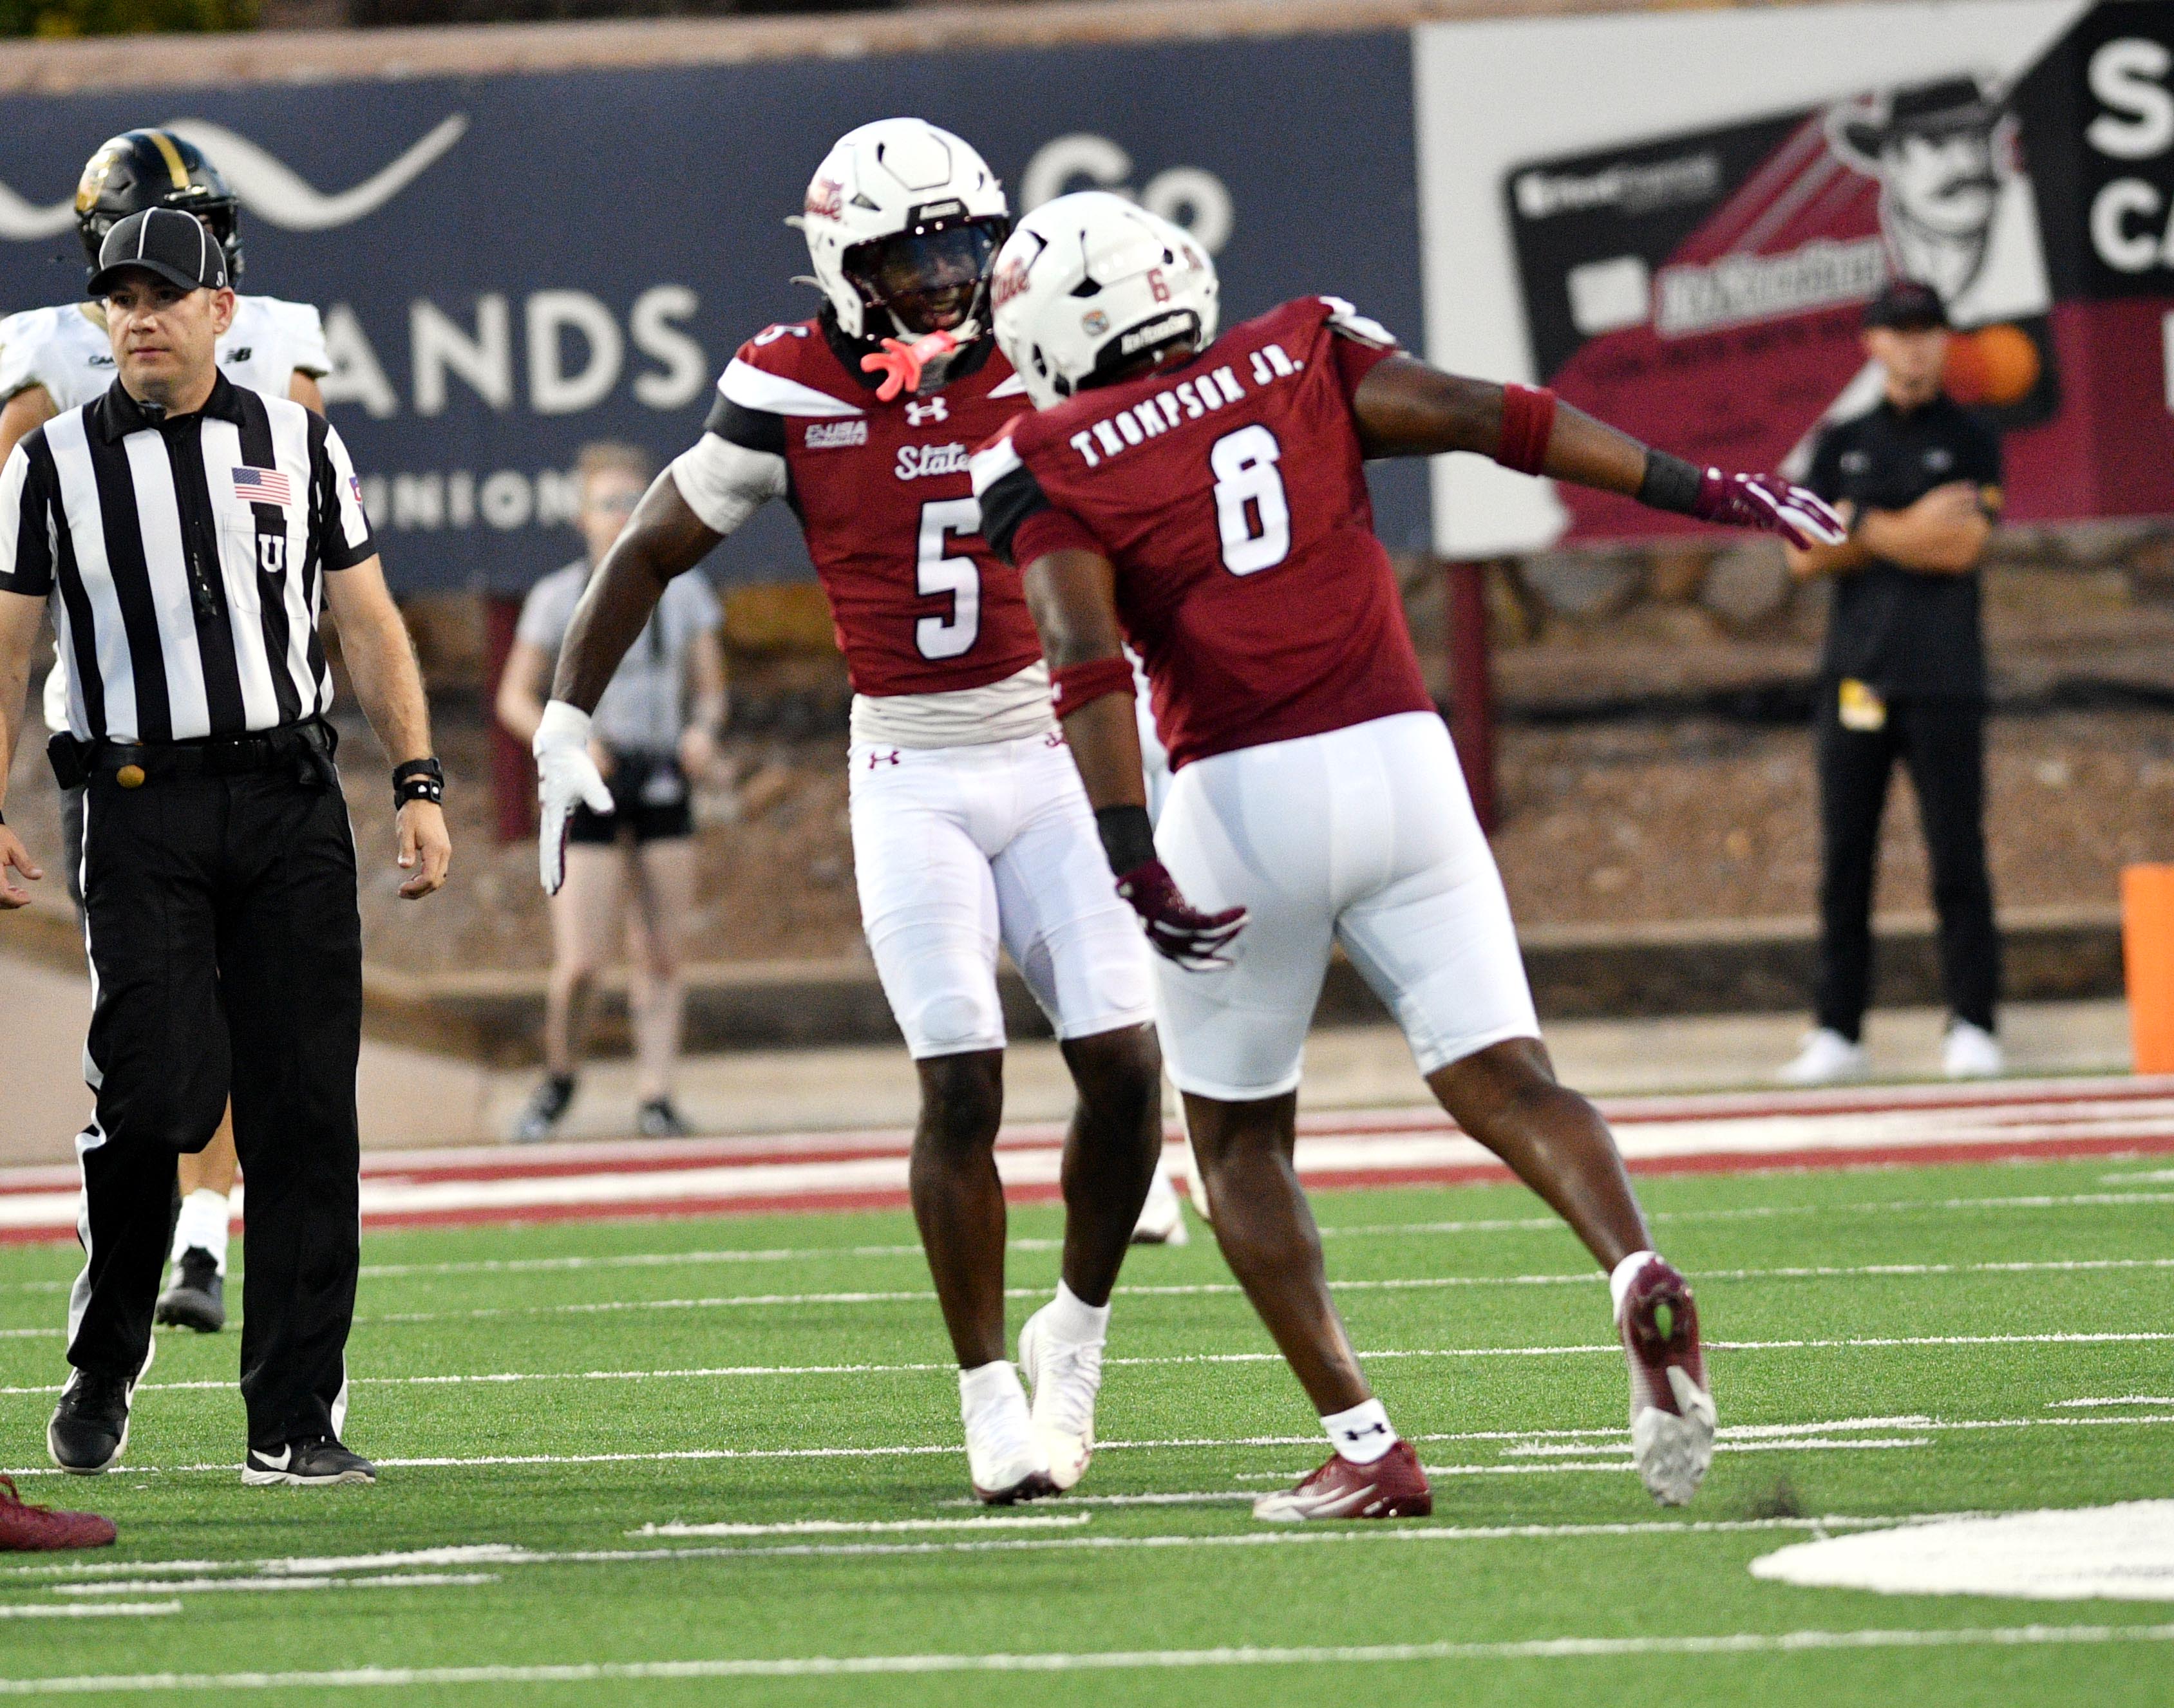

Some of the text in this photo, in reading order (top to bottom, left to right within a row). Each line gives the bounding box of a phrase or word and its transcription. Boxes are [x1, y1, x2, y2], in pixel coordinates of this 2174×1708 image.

[1146, 267, 1171, 303] 6
[1069, 343, 1305, 468] THOMPSON JR.
[894, 442, 970, 480] State
[258, 533, 285, 573] U
[916, 496, 983, 661] 5
